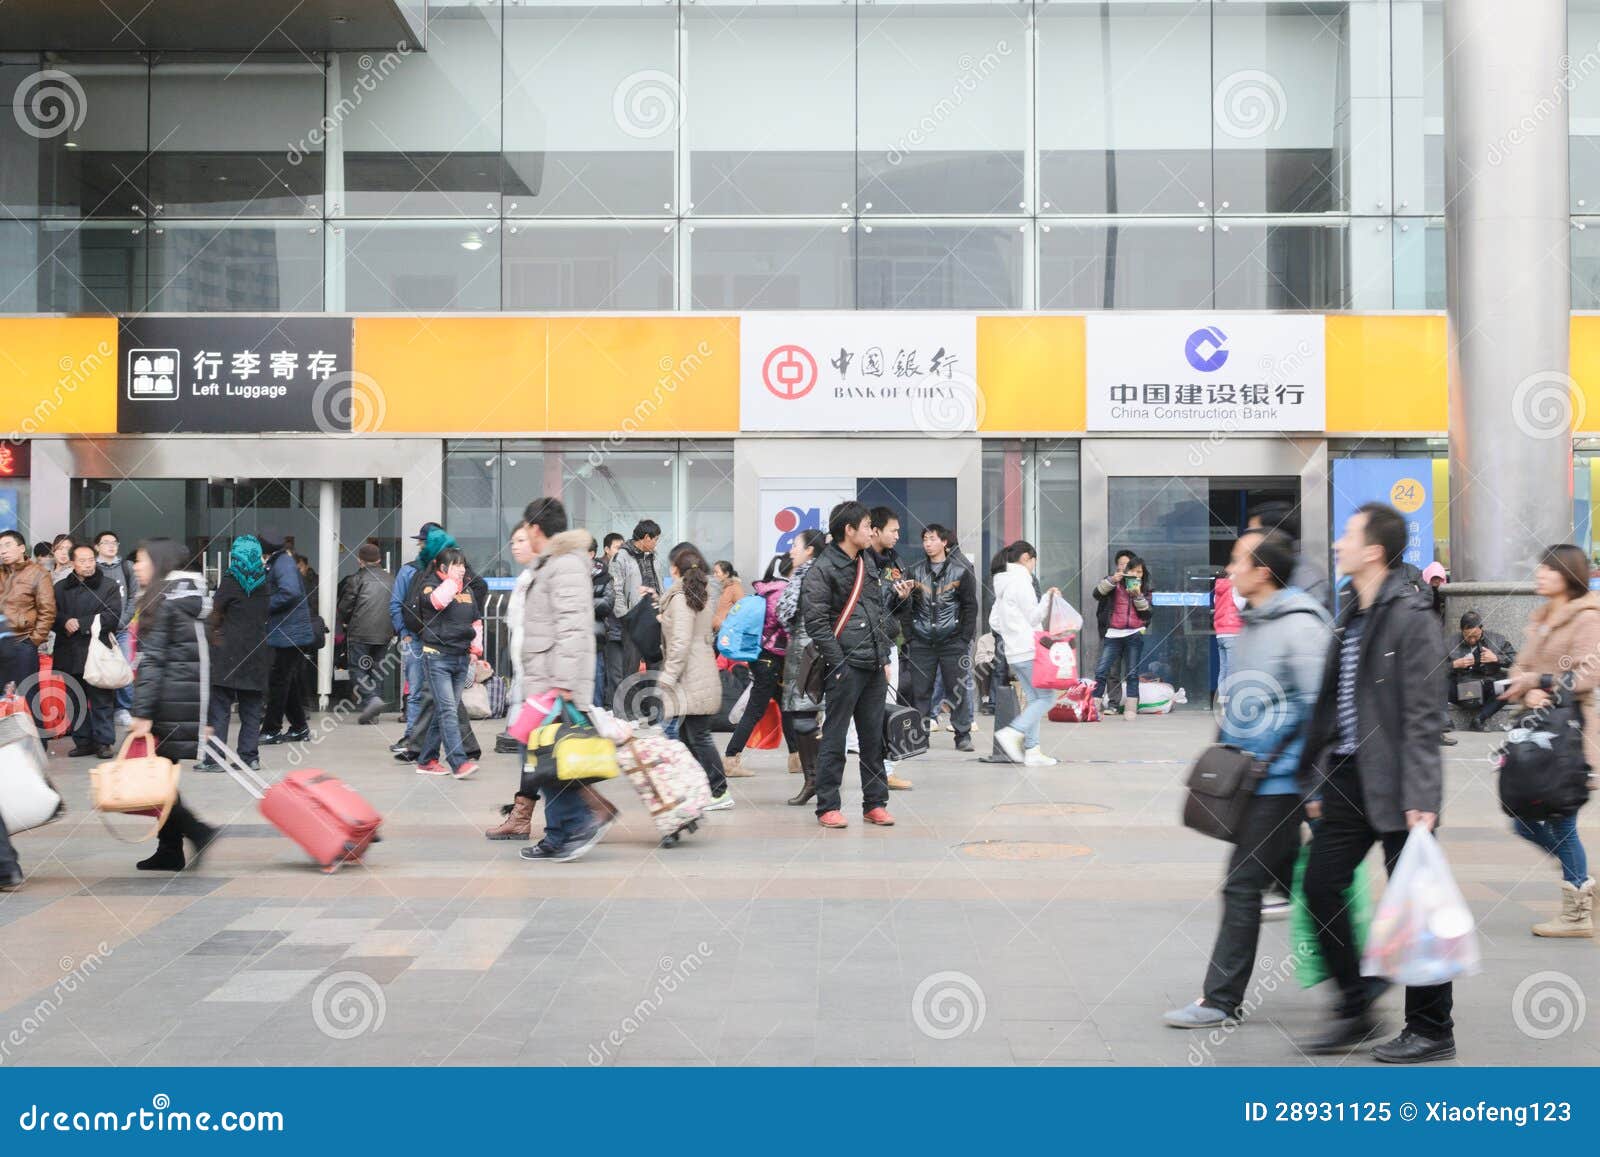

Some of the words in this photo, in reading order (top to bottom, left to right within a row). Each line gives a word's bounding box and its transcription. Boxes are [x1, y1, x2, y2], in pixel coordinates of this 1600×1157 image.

[193, 350, 337, 380] 行李寄存
[192, 383, 219, 396] Left
[226, 383, 287, 398] Luggage
[834, 387, 875, 398] BANK
[881, 387, 897, 398] OF
[906, 387, 955, 398] CHINA
[1110, 383, 1305, 405] 中国建设银行
[1111, 406, 1149, 419] China
[1154, 406, 1237, 419] Construction
[1243, 406, 1278, 419] Bank
[1395, 484, 1416, 500] 24
[1408, 519, 1421, 567] 自助银
